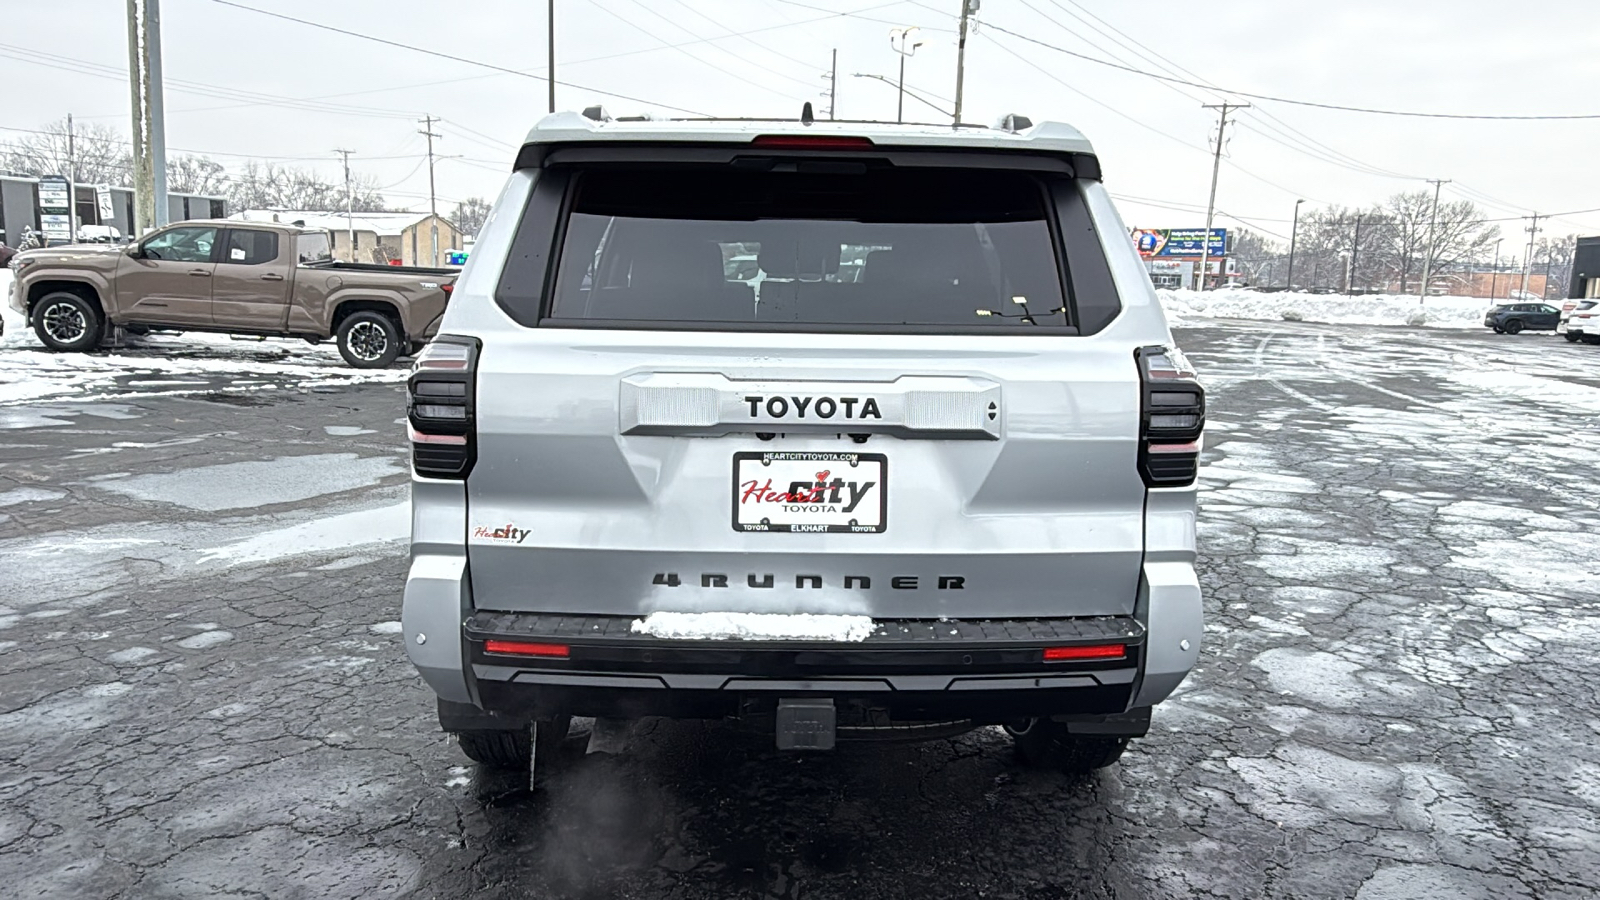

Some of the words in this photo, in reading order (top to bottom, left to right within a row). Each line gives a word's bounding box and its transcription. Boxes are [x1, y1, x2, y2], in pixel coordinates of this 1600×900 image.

[745, 396, 882, 419] TOYOTA
[763, 453, 858, 461] HEARTCITYTOYOTA.COM
[741, 478, 837, 504] Heart
[786, 470, 877, 513] city
[781, 505, 837, 513] TOYOTA
[790, 524, 829, 532] ELKHART
[652, 572, 966, 590] 4RUNNER
